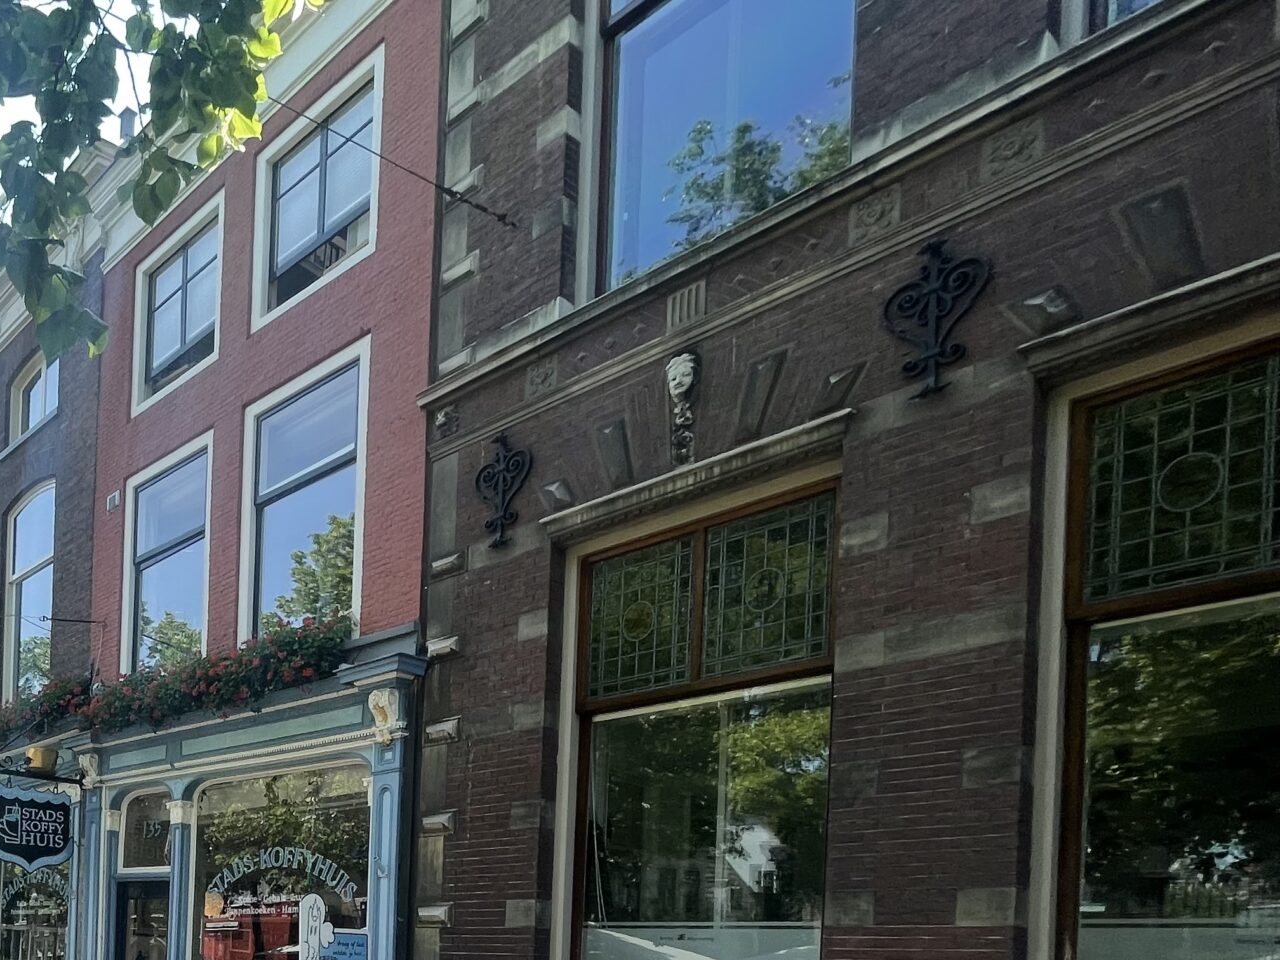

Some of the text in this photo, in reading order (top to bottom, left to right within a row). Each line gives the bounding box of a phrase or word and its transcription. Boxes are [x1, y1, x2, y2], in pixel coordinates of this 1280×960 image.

[22, 807, 64, 823] STADS
[21, 820, 64, 834] KOFFY
[21, 832, 64, 848] HUIS
[208, 846, 358, 902] STADS-KOFFYHUIS
[282, 905, 300, 914] Ham
